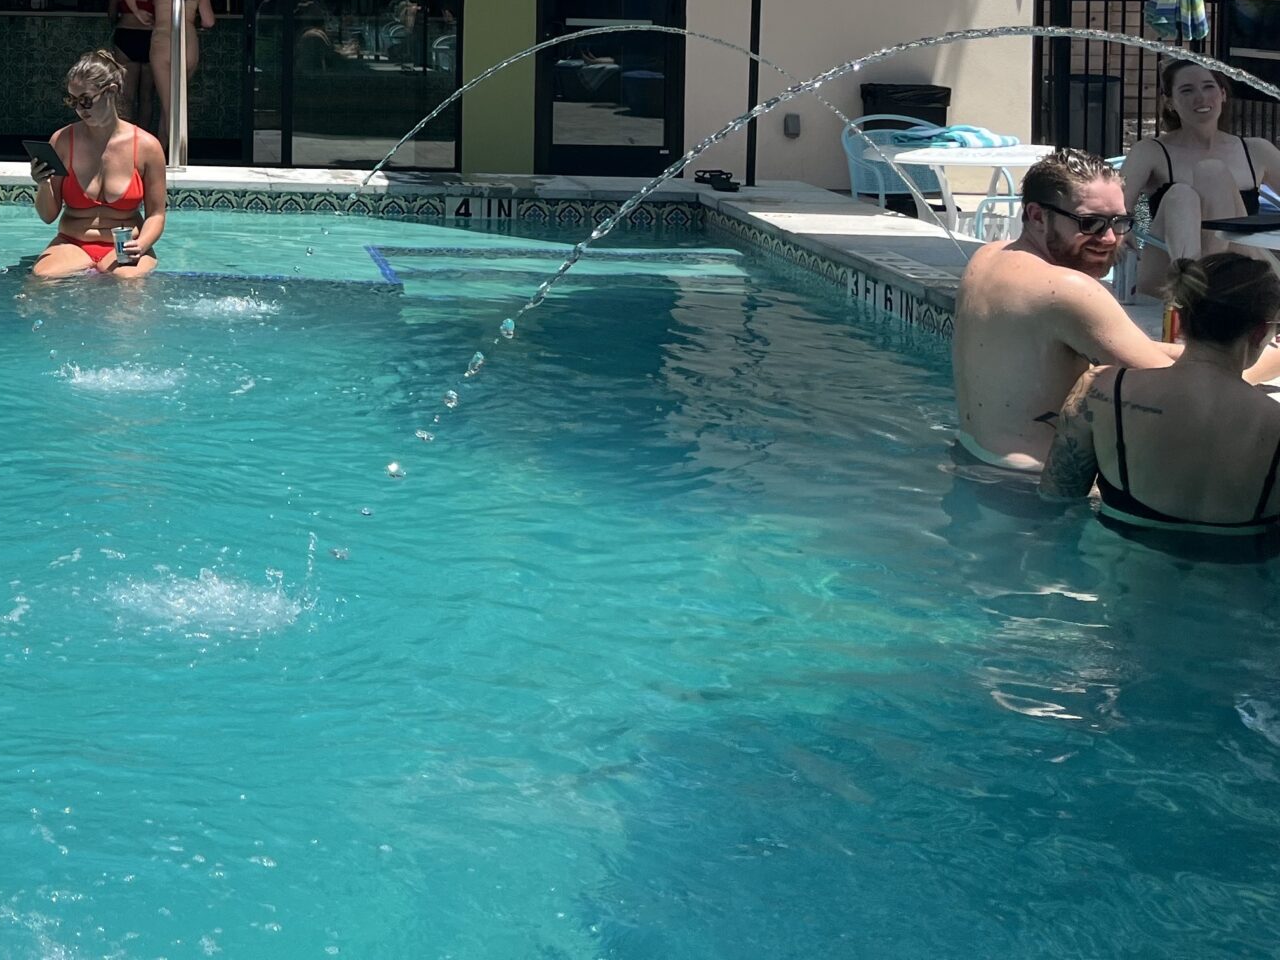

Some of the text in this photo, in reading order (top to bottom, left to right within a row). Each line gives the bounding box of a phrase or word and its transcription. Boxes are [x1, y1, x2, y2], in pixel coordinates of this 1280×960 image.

[455, 197, 512, 218] 4 IN
[851, 271, 914, 324] 3 FT 6 IN
